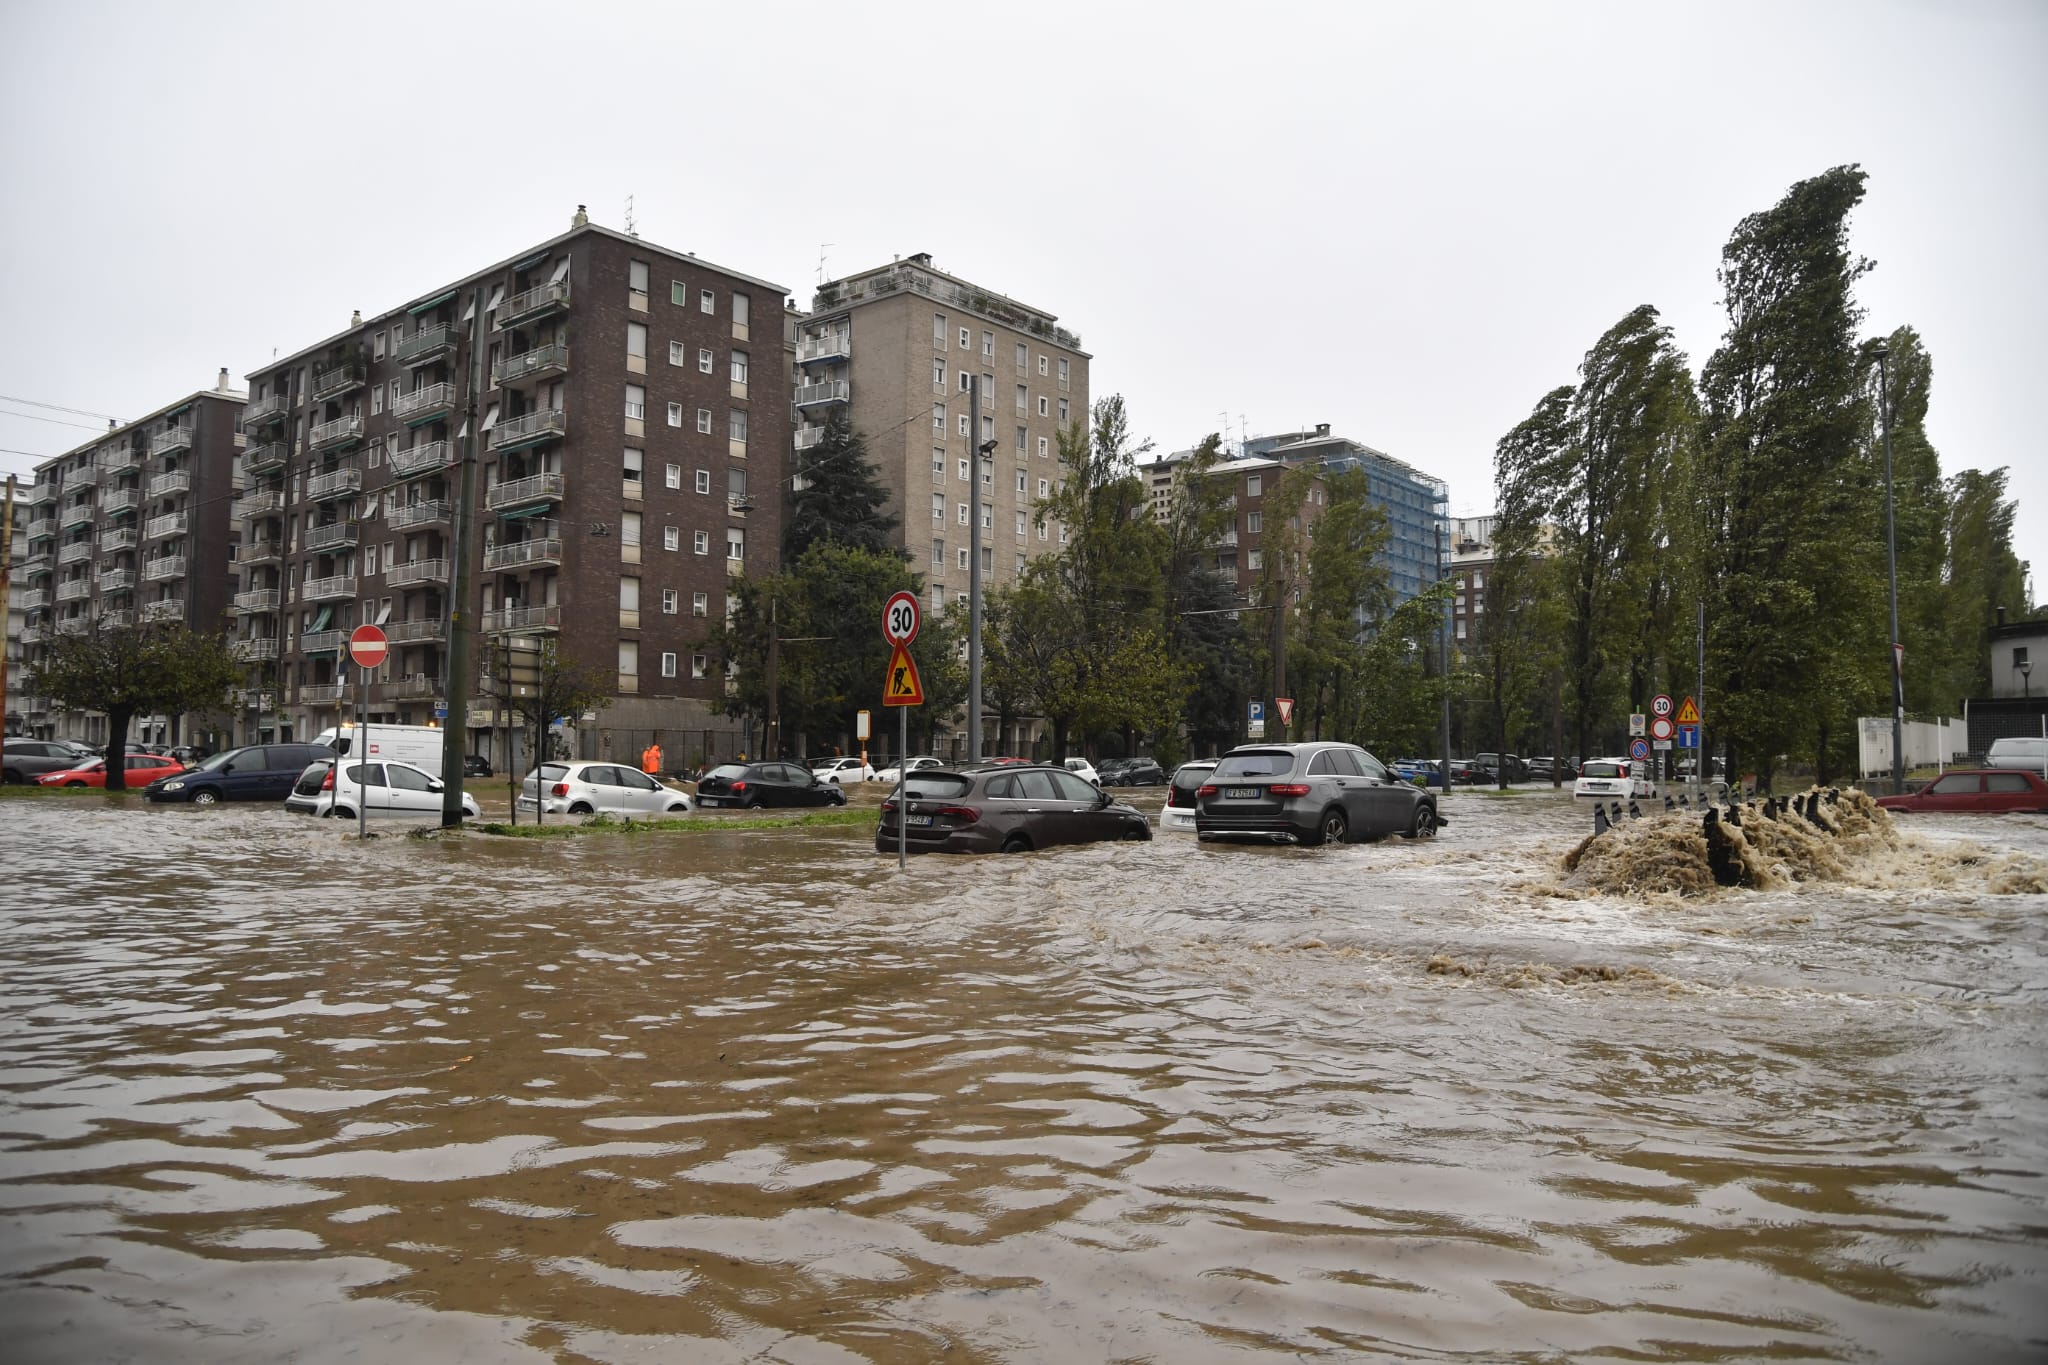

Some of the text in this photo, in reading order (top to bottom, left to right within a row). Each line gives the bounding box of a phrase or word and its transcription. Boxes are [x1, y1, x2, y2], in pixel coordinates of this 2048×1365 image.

[891, 606, 912, 633] 30
[1250, 703, 1261, 719] P
[1656, 701, 1668, 712] 30
